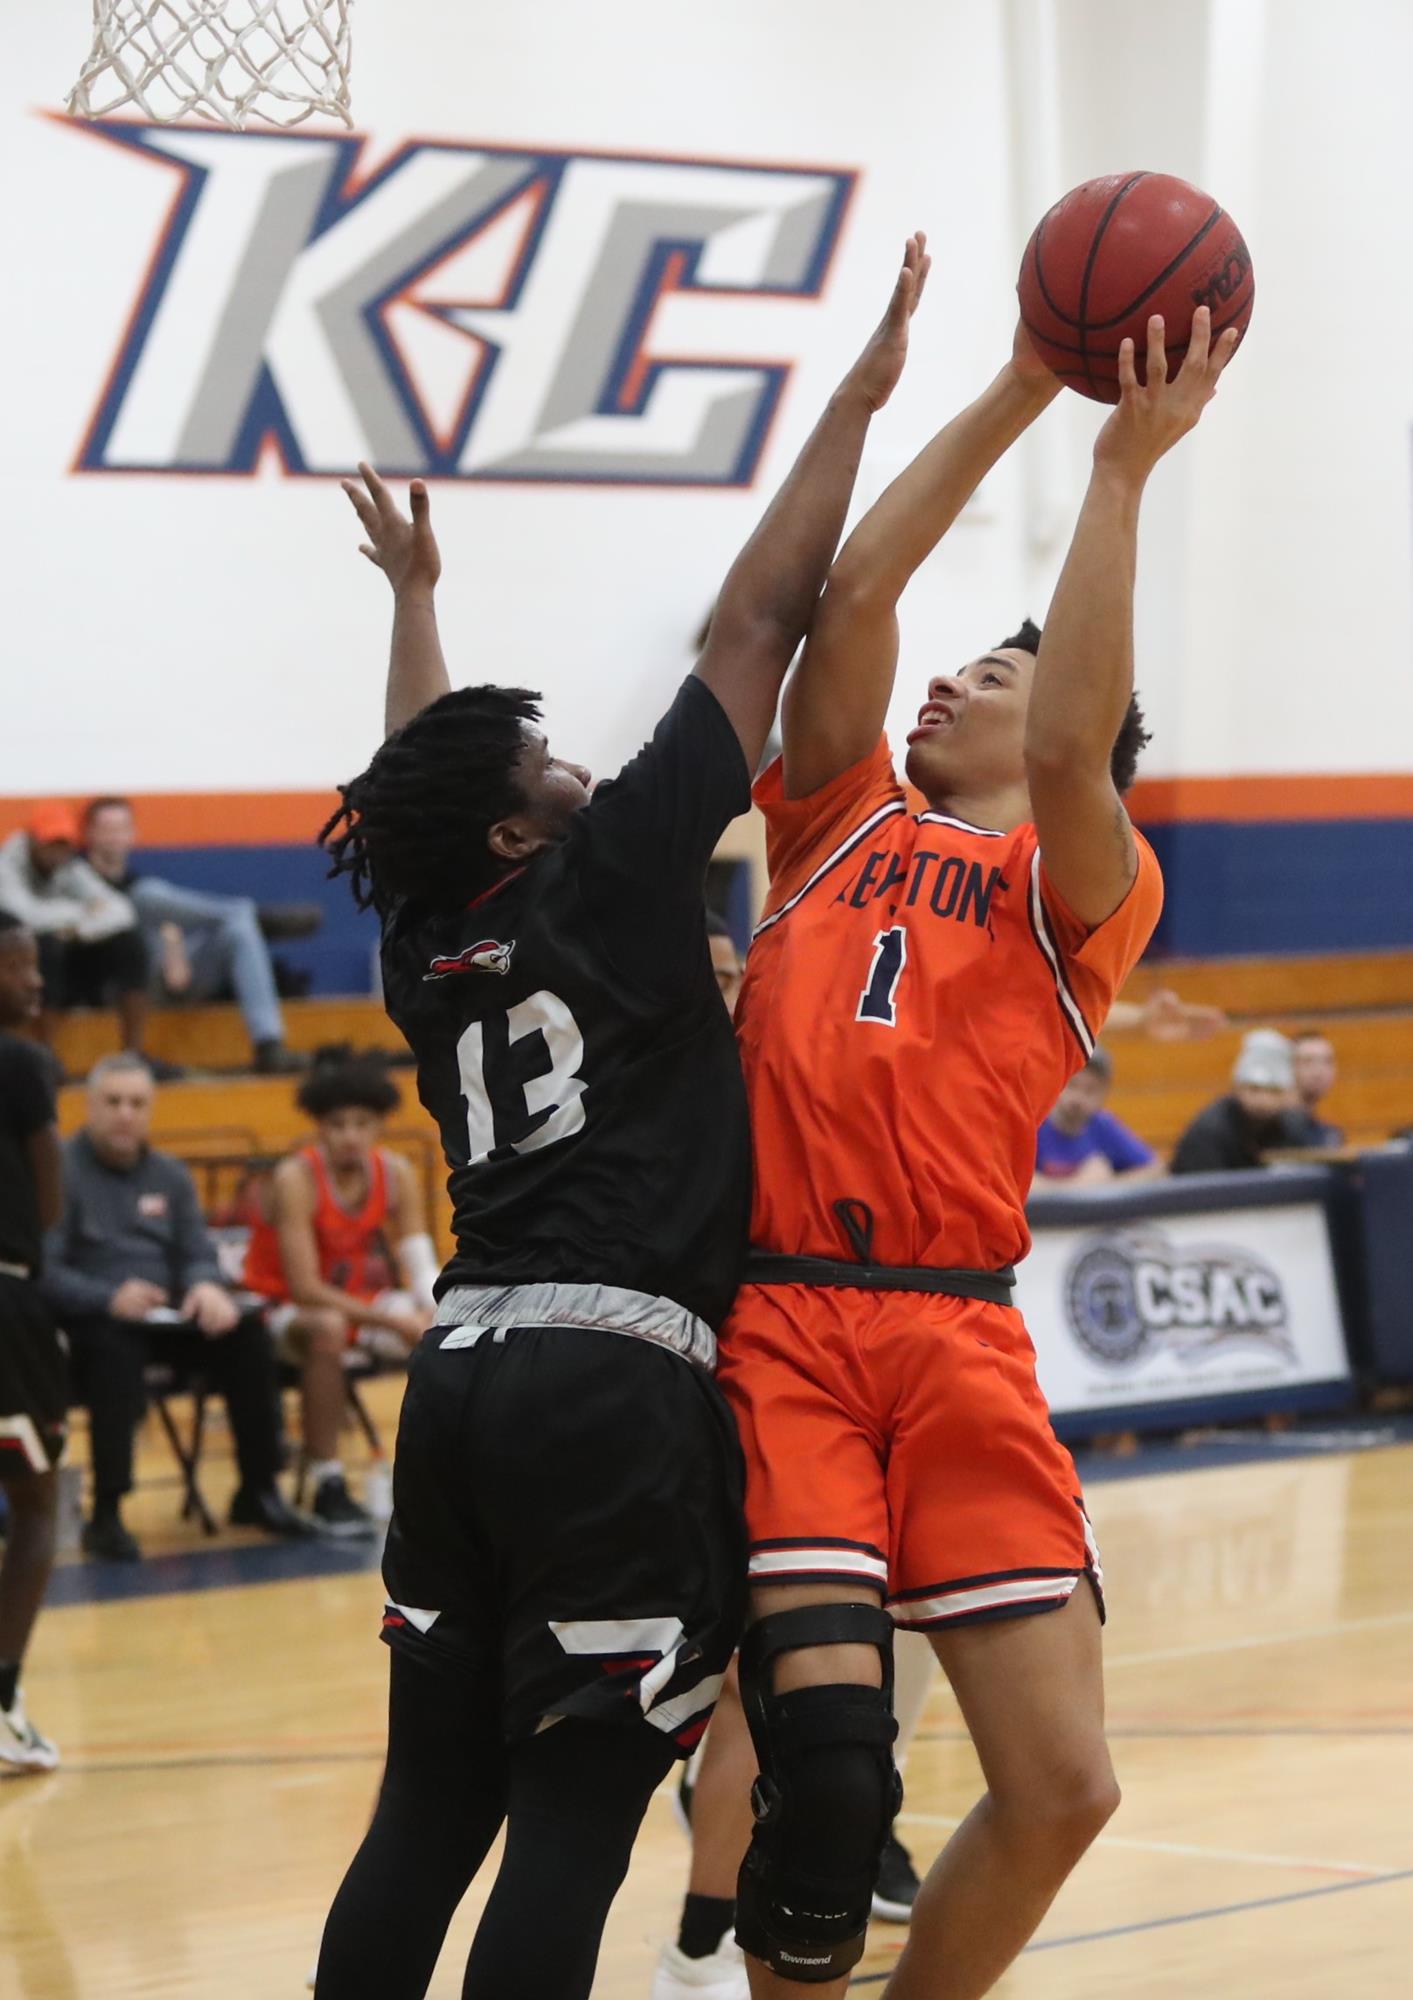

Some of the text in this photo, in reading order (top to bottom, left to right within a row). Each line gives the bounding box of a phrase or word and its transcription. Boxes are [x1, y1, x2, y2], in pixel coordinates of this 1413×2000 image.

[855, 925, 907, 1026] 1
[457, 990, 589, 1166] 13
[1134, 1258, 1284, 1326] CSAC
[780, 1951, 832, 1965] Townsend
